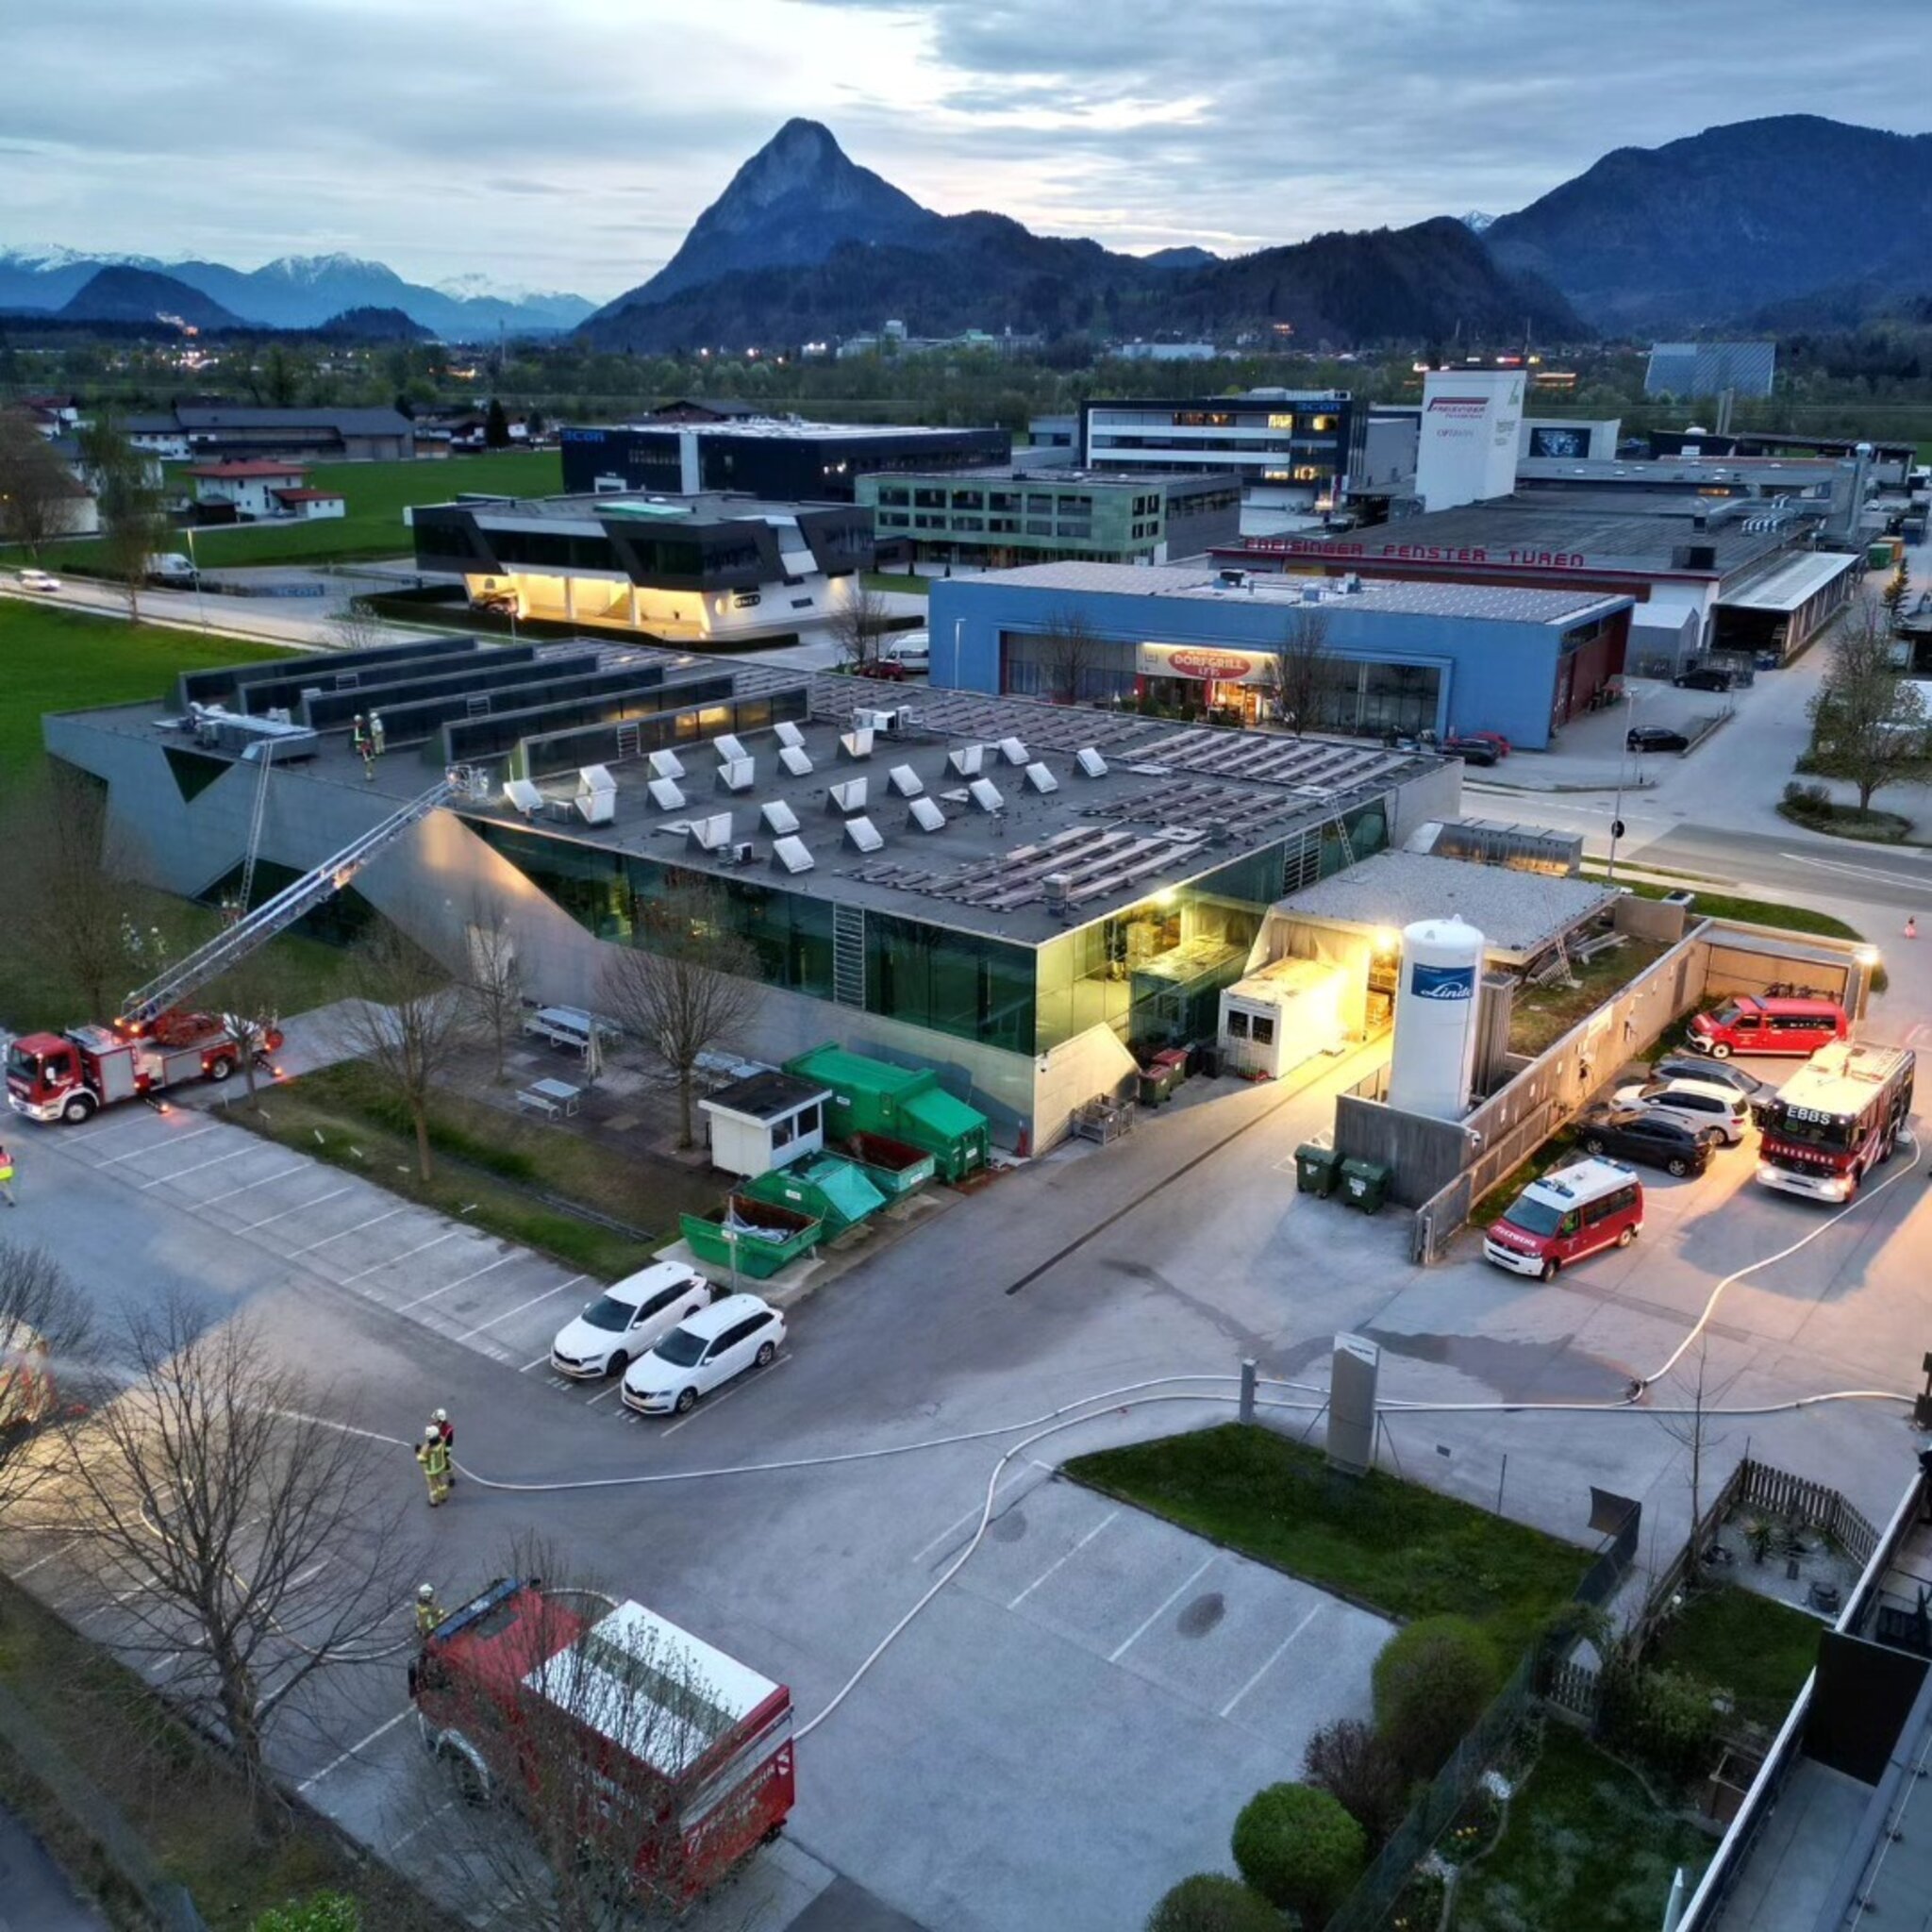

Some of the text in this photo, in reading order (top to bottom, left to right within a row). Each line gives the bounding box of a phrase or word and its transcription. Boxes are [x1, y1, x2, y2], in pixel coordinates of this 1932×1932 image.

[1383, 543, 1486, 562] FENSTER
[1420, 981, 1473, 998] Linde
[1787, 1106, 1831, 1125] EBBS
